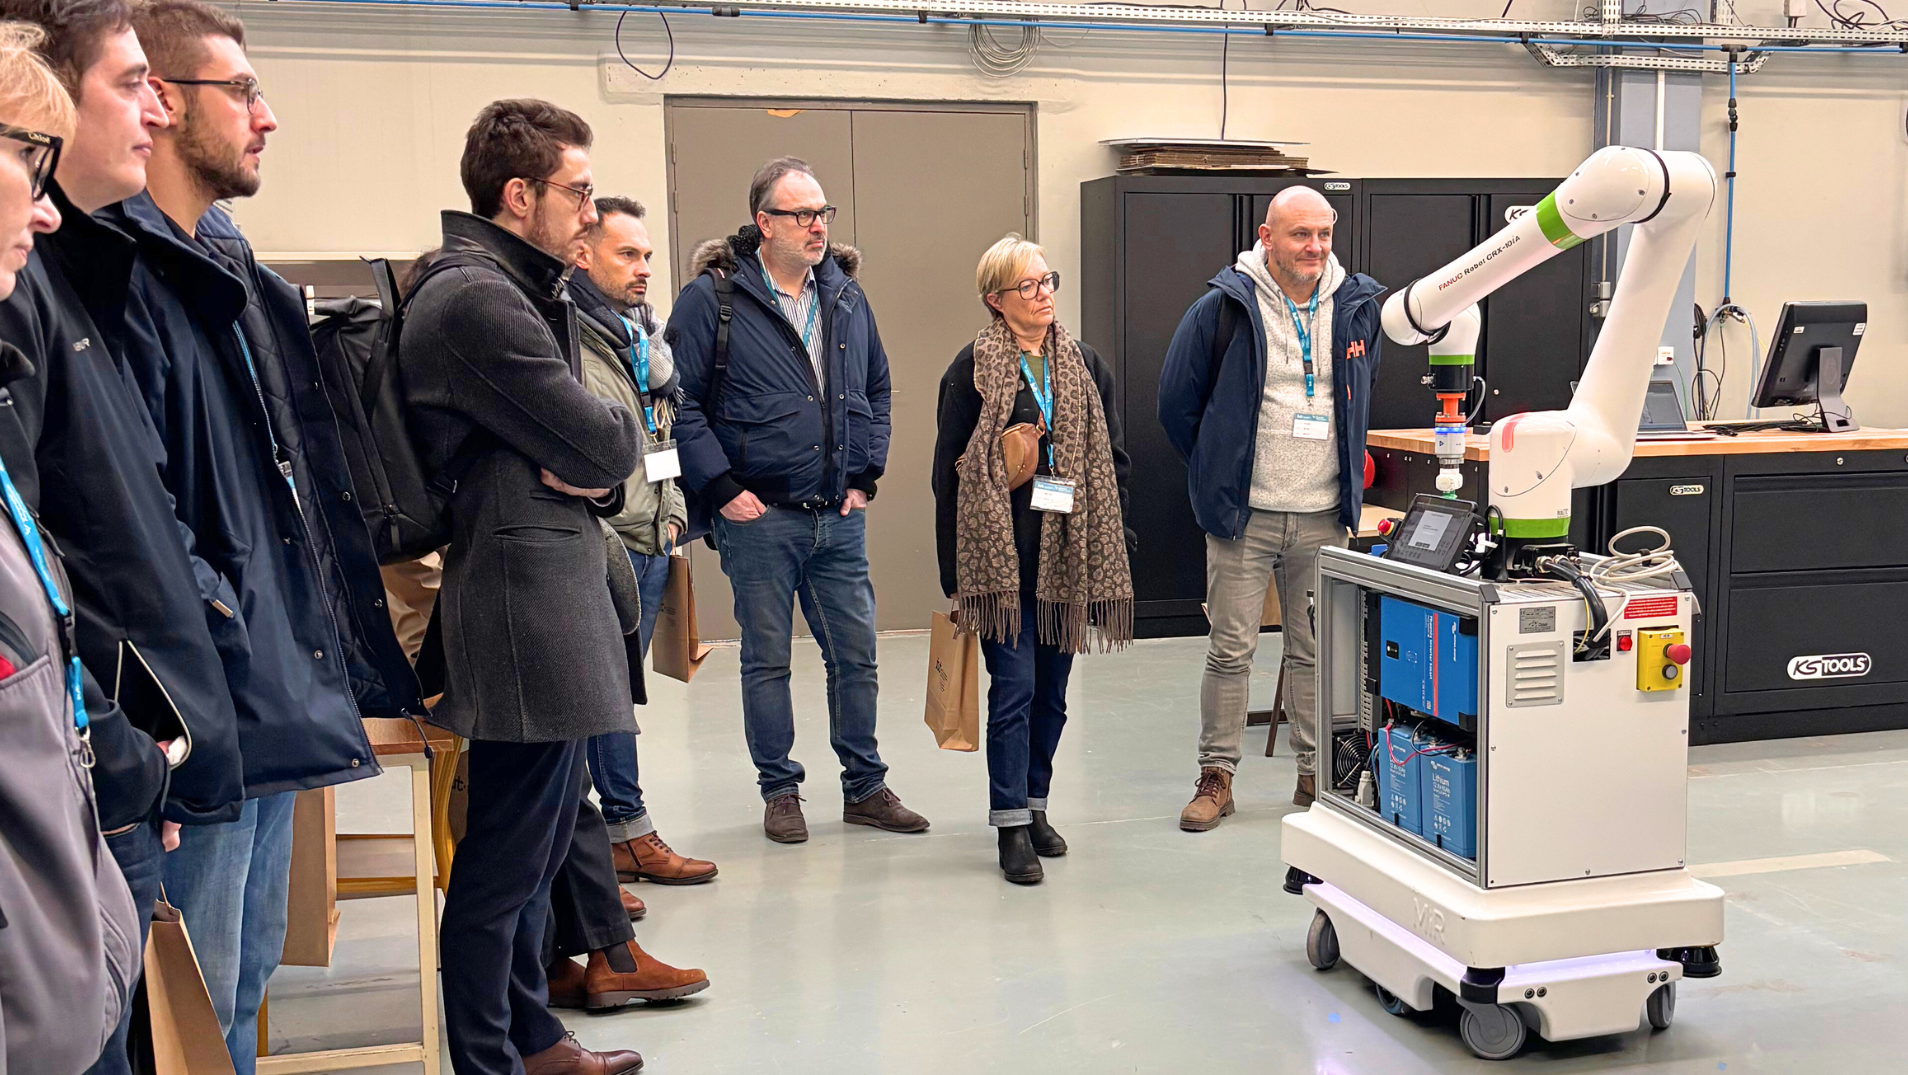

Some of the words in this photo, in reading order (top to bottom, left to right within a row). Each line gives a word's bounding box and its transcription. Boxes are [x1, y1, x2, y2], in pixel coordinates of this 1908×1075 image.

[1438, 272, 1464, 292] FANUC
[1464, 258, 1487, 276] Robot
[1793, 659, 1822, 676] KS
[1821, 657, 1866, 674] TOOLS
[1432, 772, 1450, 787] Lithium
[1413, 897, 1446, 946] MiR
